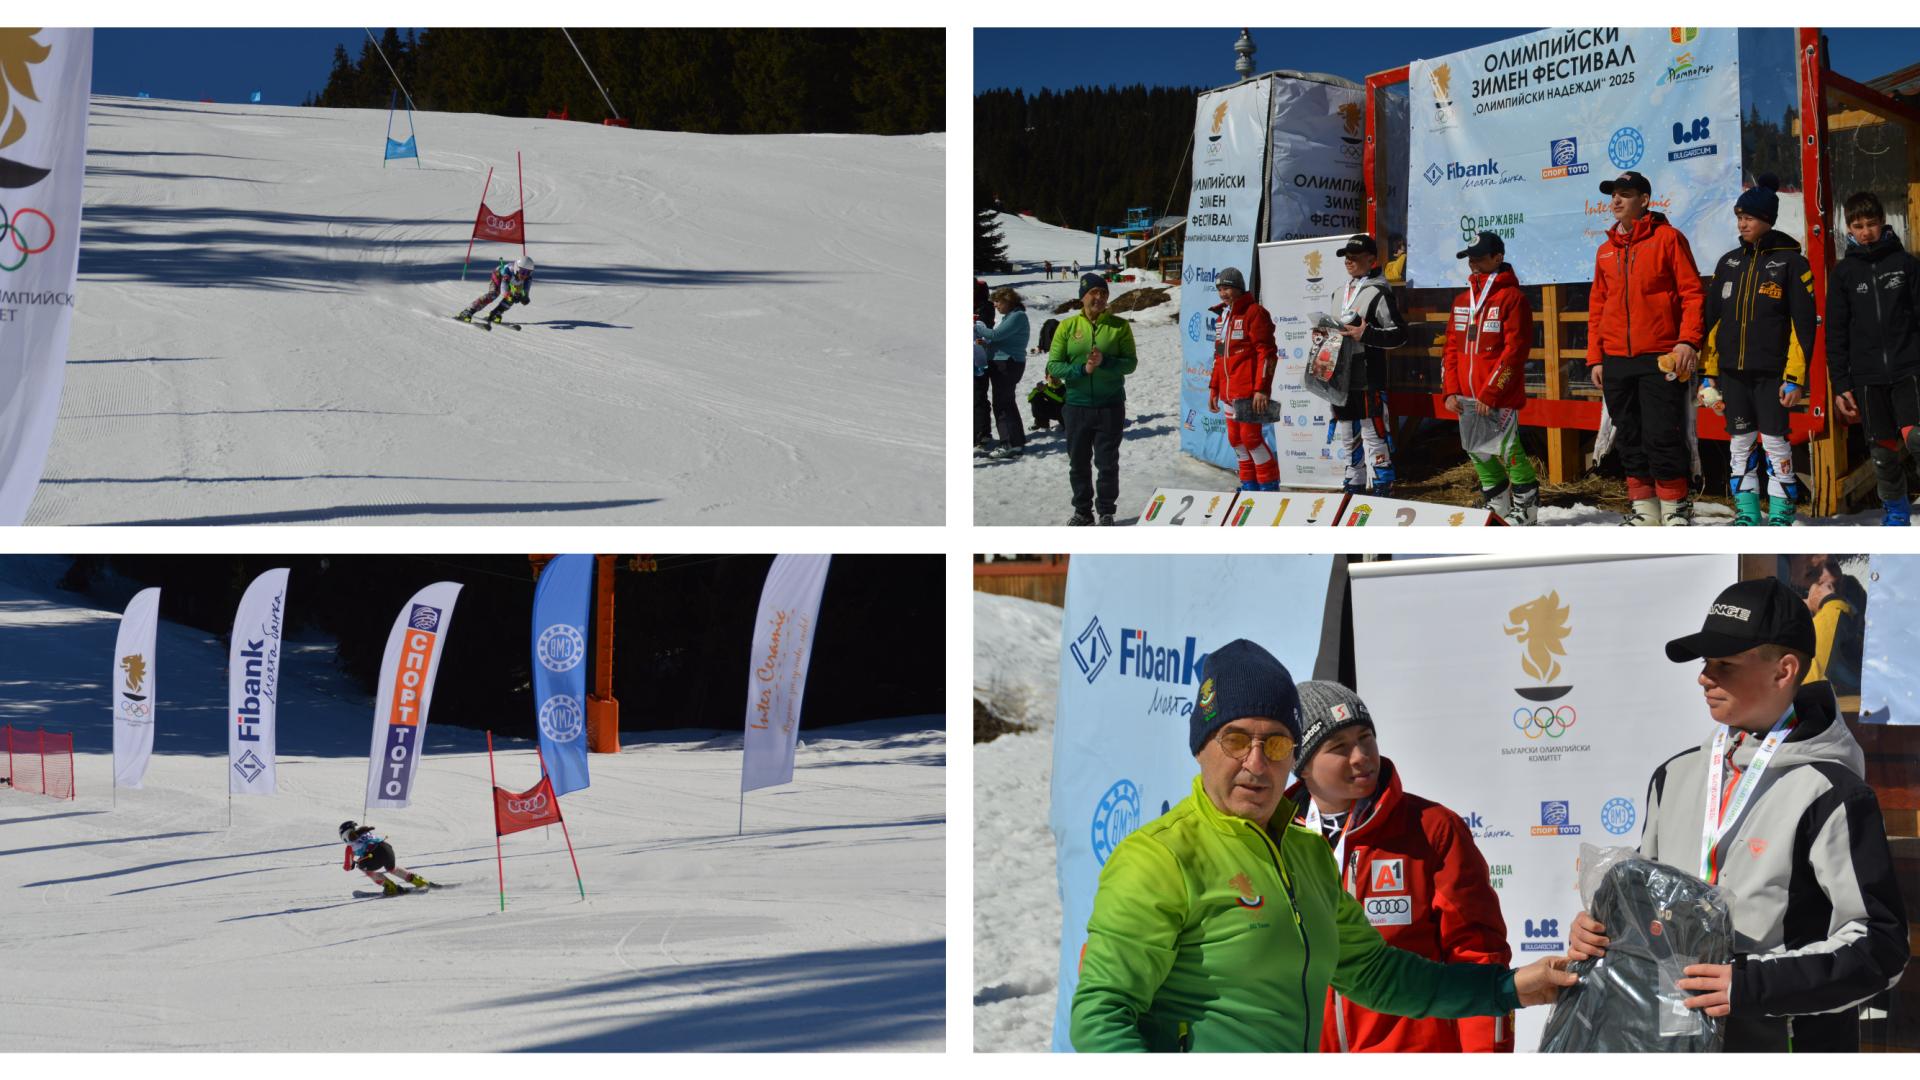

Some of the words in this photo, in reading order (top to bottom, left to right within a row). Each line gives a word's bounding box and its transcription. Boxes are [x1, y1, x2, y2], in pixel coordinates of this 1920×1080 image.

[1484, 27, 1619, 73] ОЛИМПИЙСКИ
[1472, 69, 1528, 98] ЗИМЕН
[1532, 45, 1636, 84] ФЕСТИВАЛ
[1609, 71, 1635, 88] 2025
[1683, 148, 1712, 160] BULGARICUM
[1446, 158, 1499, 181] Fibank
[1542, 168, 1568, 178] СПОРТ
[1568, 164, 1588, 175] ТОТО
[1324, 195, 1362, 211] ЗИМЕ
[1478, 212, 1524, 229] ДЪРЖАВНА
[1169, 495, 1194, 526] 2
[1271, 498, 1291, 526] 1
[549, 637, 572, 658] ВМЗ
[757, 610, 787, 683] Ceramic
[1119, 627, 1209, 686] Fibank
[398, 633, 429, 723] СПОРТ
[237, 639, 264, 742] Fibank
[751, 687, 773, 730] Inter
[1501, 746, 1538, 756] БЪЛГАРСКИ
[1539, 744, 1591, 755] ОЛИМПИЙСКИ
[1528, 754, 1562, 762] КОМИТЕТ
[385, 727, 409, 797] ТОТО
[1531, 825, 1558, 836] СПОРТ
[1559, 824, 1581, 835] ТОТО
[1375, 860, 1402, 890] A1
[1490, 864, 1513, 876] АВНА
[1524, 943, 1560, 951] BULGARICUM
